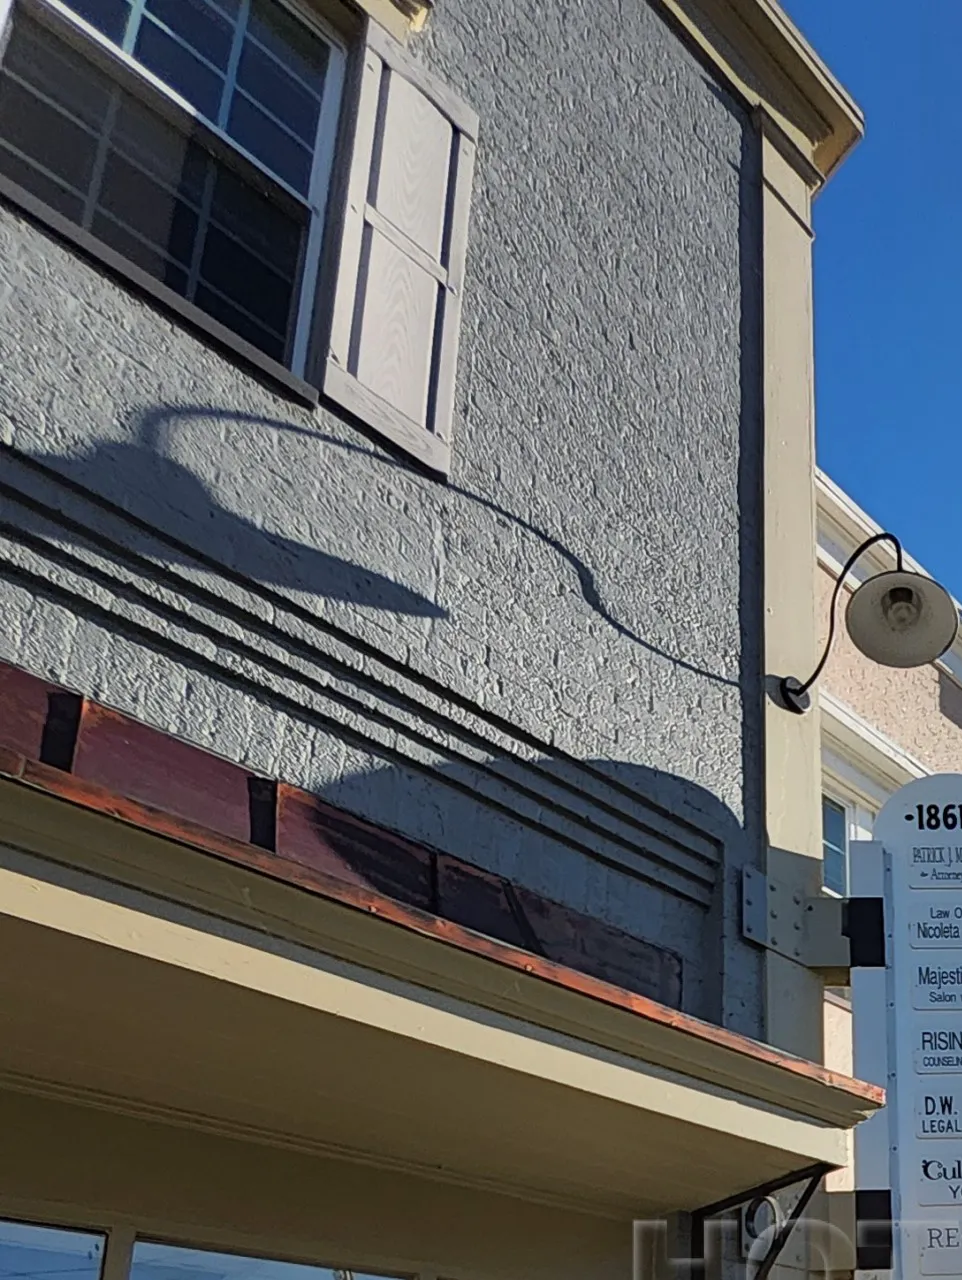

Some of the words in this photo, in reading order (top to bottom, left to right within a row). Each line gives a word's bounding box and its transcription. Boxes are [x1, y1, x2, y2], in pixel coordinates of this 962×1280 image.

[912, 846, 945, 863] PATRICK
[930, 907, 950, 919] Law
[917, 922, 960, 939] Nicoleta
[929, 991, 957, 1003] Salon
[924, 1096, 958, 1116] D.W.
[922, 1119, 962, 1133] LEGAL
